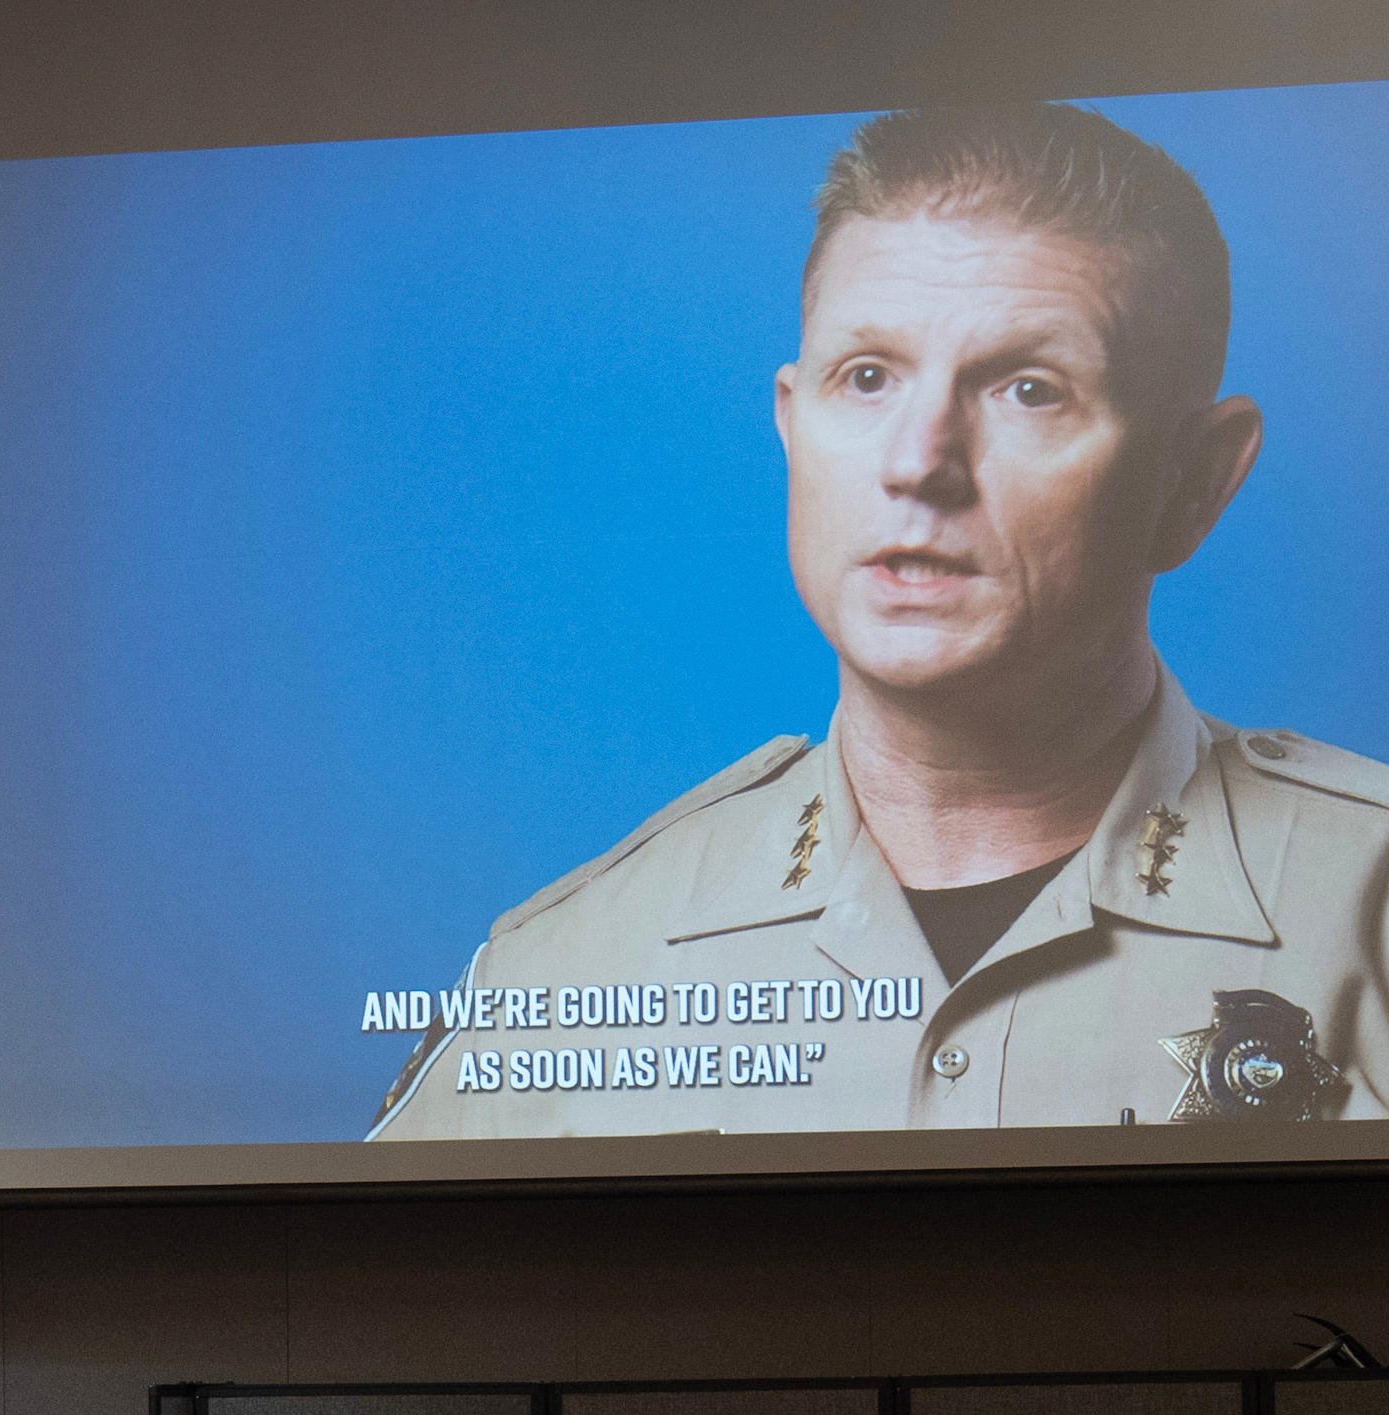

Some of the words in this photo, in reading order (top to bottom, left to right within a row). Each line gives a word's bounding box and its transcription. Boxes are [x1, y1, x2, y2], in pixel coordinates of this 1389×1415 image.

[361, 990, 431, 1031] AND
[440, 986, 548, 1028] WE’RE
[557, 984, 664, 1026] GOING
[673, 982, 717, 1023] TO
[726, 980, 790, 1021] GET
[797, 979, 840, 1020] TO
[850, 977, 920, 1017] YOU
[457, 1051, 501, 1091] AS
[510, 1048, 604, 1089] SOON
[612, 1047, 656, 1087] AS
[664, 1046, 720, 1086] WE
